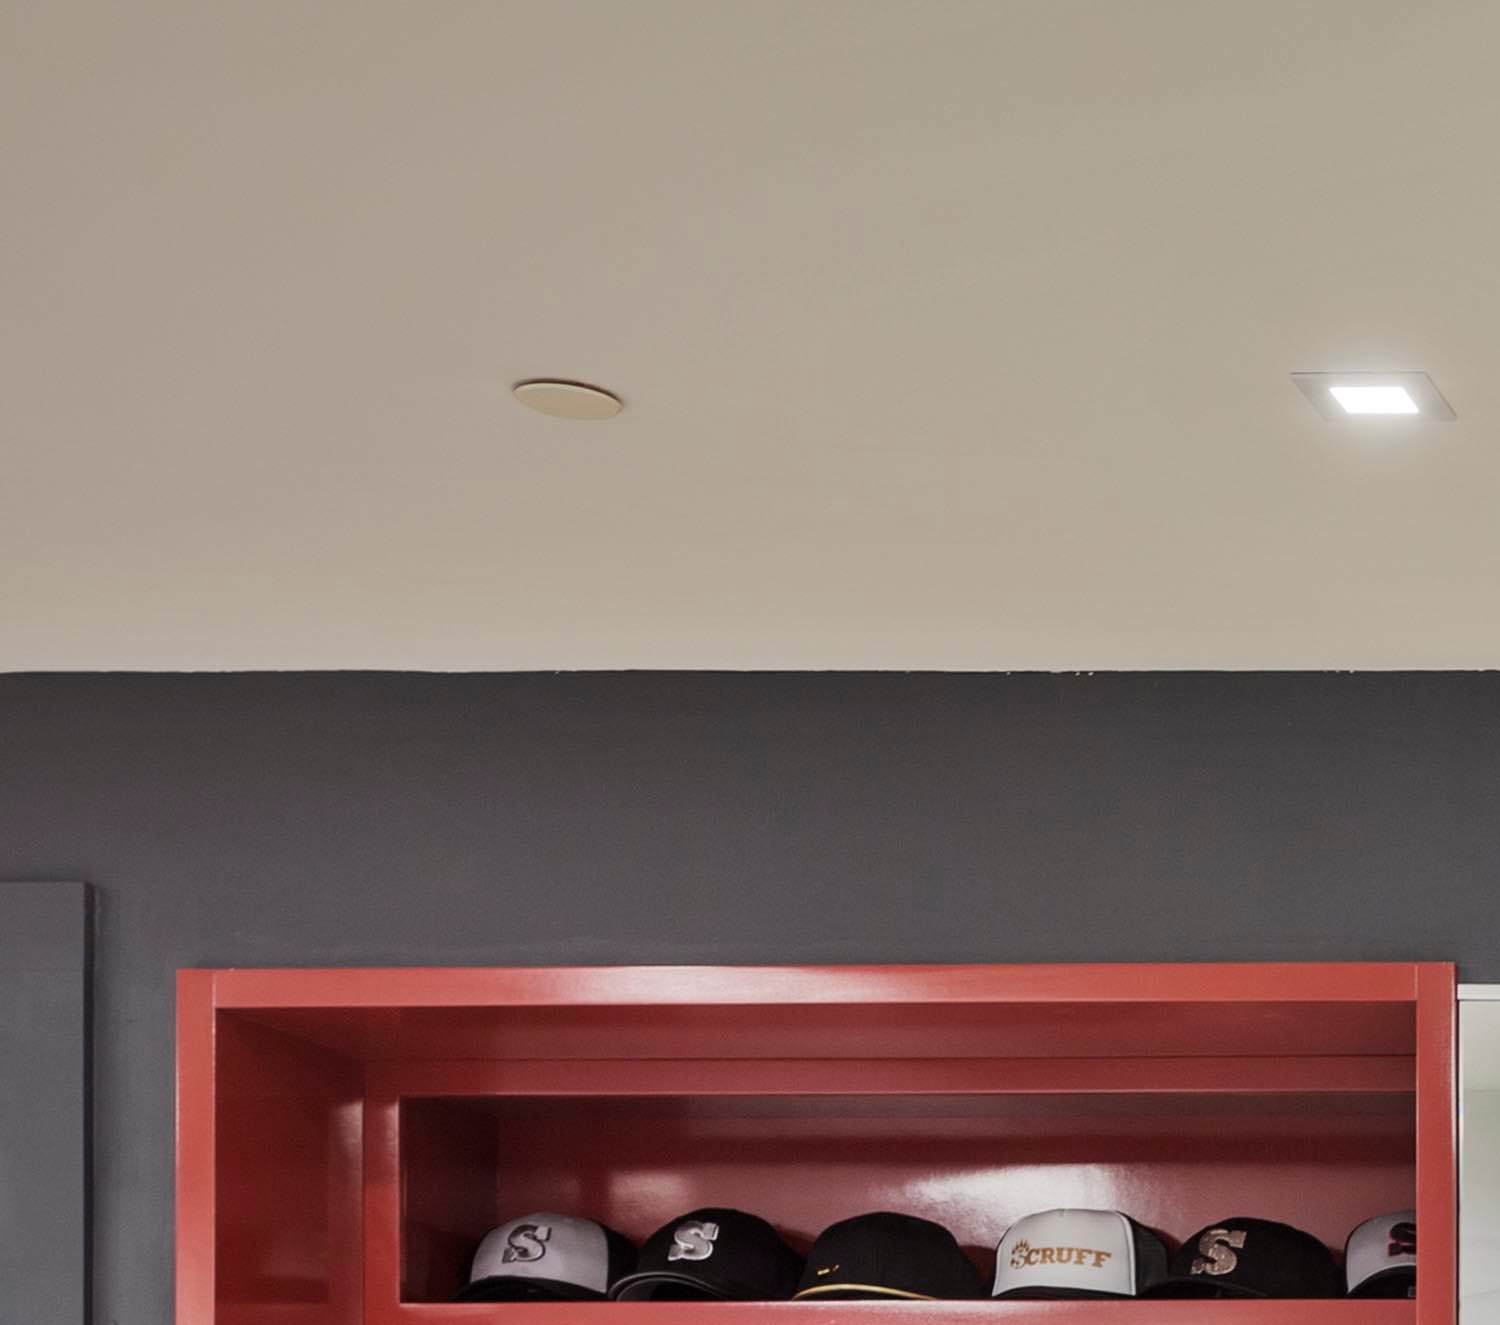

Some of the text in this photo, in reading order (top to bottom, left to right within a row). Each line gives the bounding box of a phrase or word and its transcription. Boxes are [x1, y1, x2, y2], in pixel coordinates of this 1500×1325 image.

[502, 1224, 551, 1263] S
[668, 1221, 719, 1262] S
[1009, 1238, 1112, 1270] SCRUFF
[1190, 1229, 1246, 1275] S
